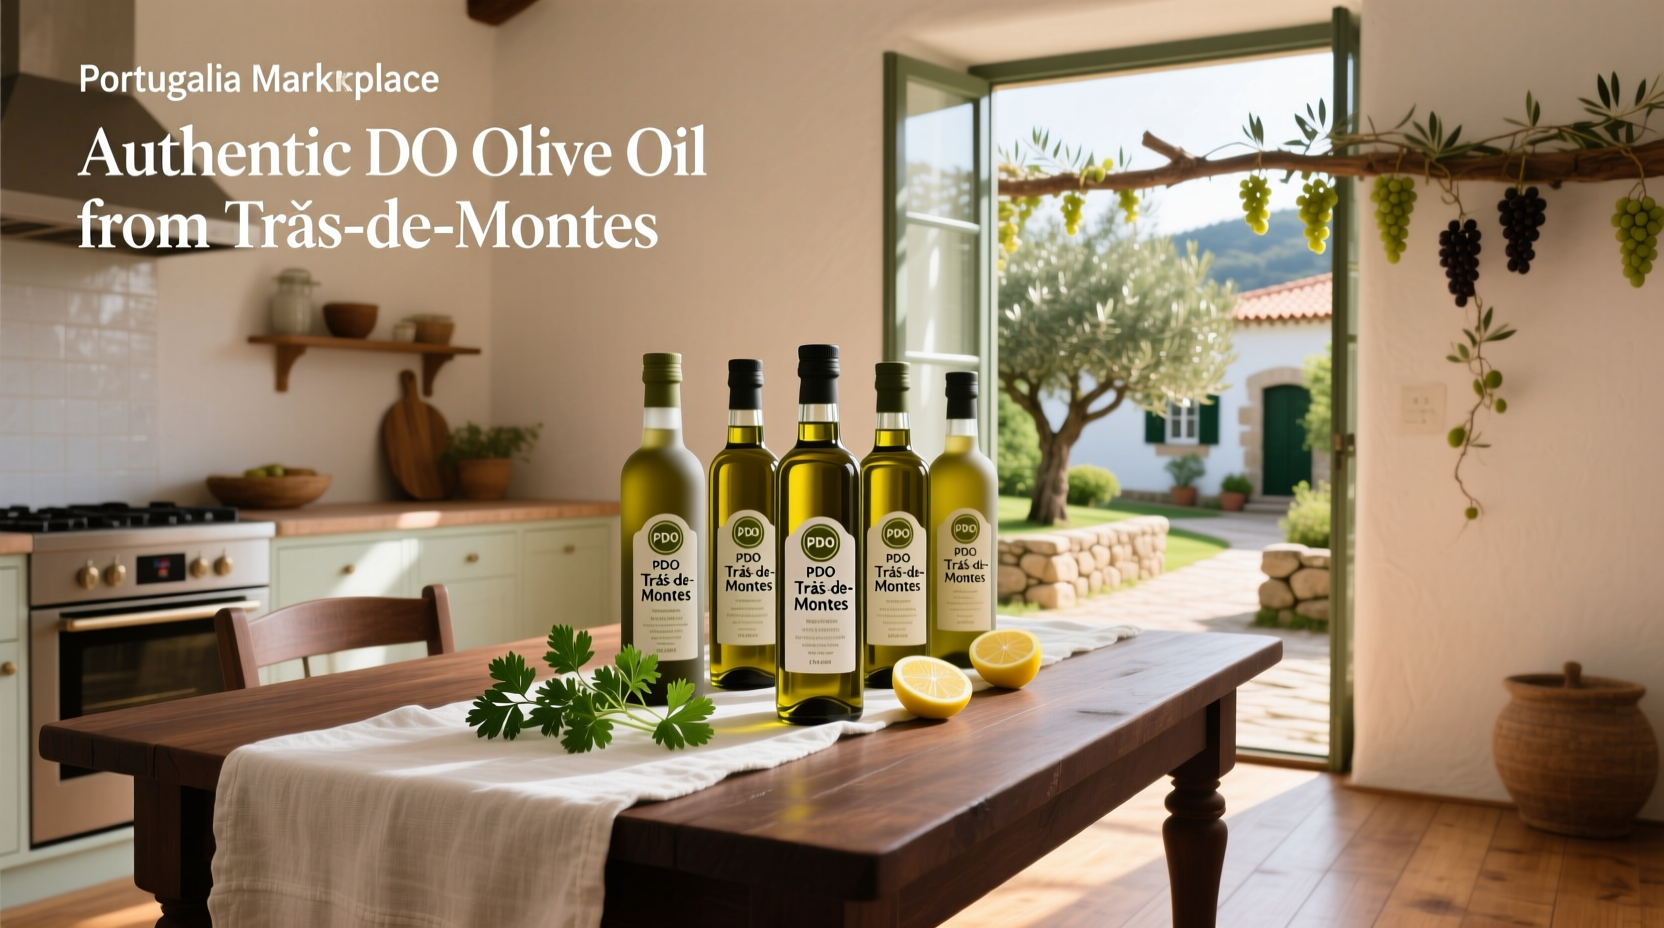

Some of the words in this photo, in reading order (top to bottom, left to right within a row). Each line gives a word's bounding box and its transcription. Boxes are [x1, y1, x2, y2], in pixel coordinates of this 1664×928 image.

[737, 526, 760, 537] PDO
[886, 528, 910, 539] PDO
[955, 523, 977, 534] PDO
[653, 532, 679, 543] PDO
[806, 536, 835, 549] PDO
[736, 552, 761, 563] PDO
[886, 553, 911, 563] PDO
[954, 547, 977, 557] PDO
[652, 559, 680, 571] PDO
[806, 566, 836, 578] PDO
[944, 571, 986, 584] Montes
[725, 579, 773, 592] Montes
[874, 579, 921, 592] Montes
[641, 588, 691, 602] Montes
[794, 596, 849, 611] Montes
